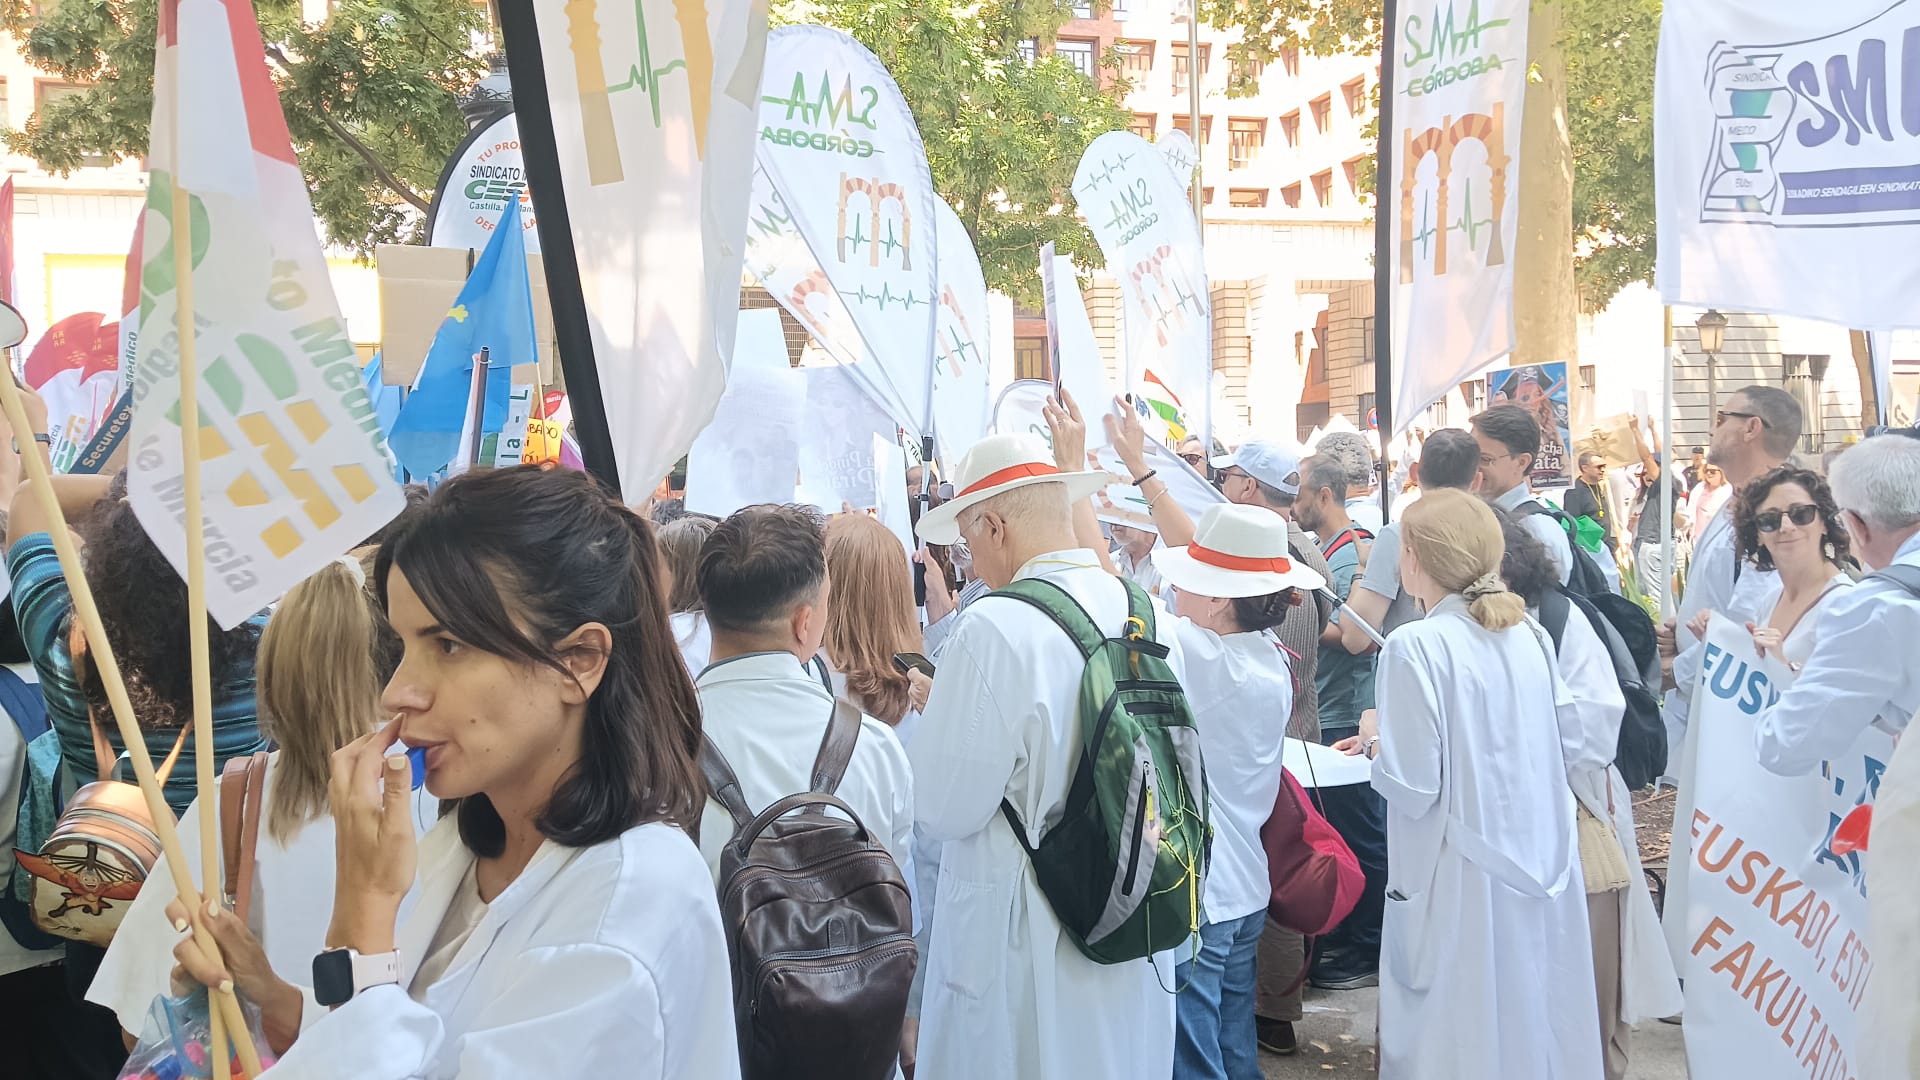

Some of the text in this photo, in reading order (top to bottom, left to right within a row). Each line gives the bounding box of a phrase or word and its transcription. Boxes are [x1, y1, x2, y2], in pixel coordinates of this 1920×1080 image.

[1404, 0, 1511, 67] SMA
[1407, 54, 1503, 97] CÓRDOBA
[470, 165, 520, 180] SINDICATO
[477, 141, 522, 162] TU PRO
[1877, 180, 1920, 194] SINDIKAT
[82, 404, 134, 468] Securetex
[1690, 808, 1840, 973] EUSKADI,
